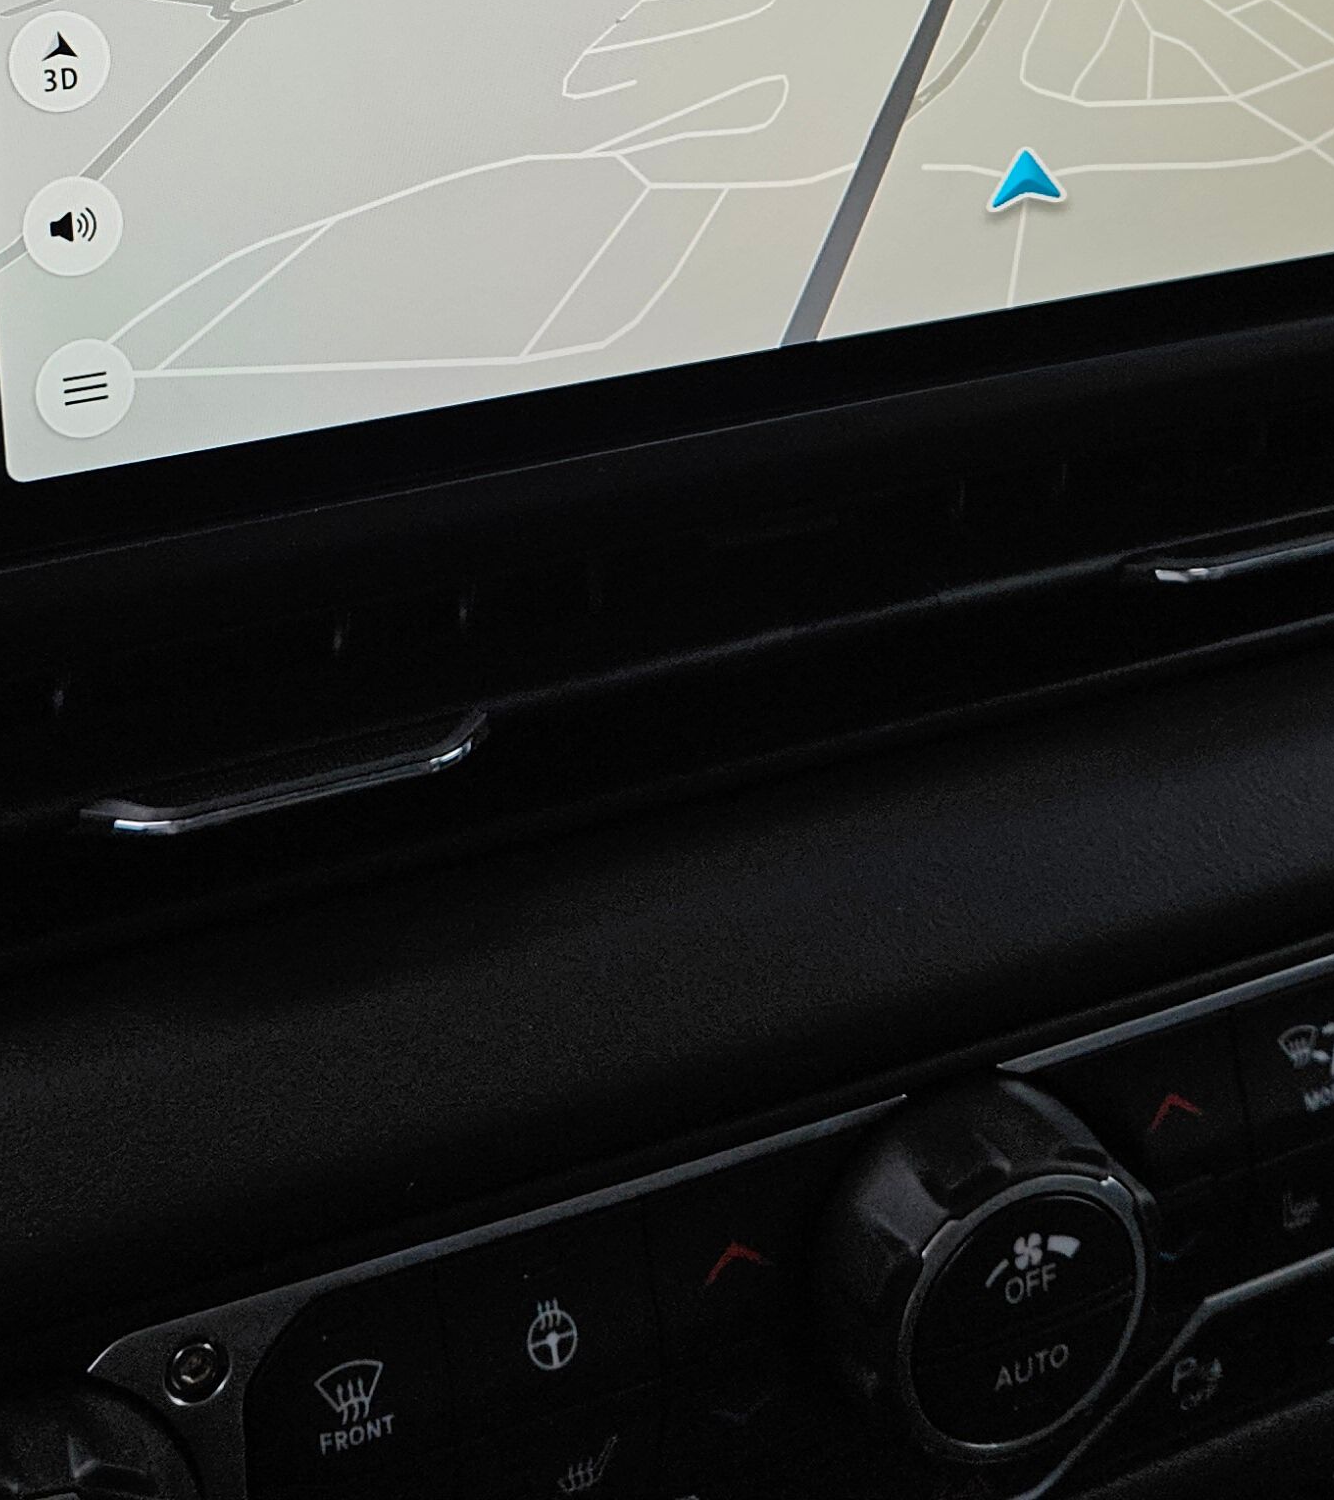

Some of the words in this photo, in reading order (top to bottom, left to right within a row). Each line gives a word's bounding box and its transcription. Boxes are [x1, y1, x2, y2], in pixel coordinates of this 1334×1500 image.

[43, 67, 78, 92] 3D
[1004, 1262, 1058, 1305] OFF
[993, 1343, 1070, 1392] AUTO
[319, 1413, 396, 1455] FRONT
